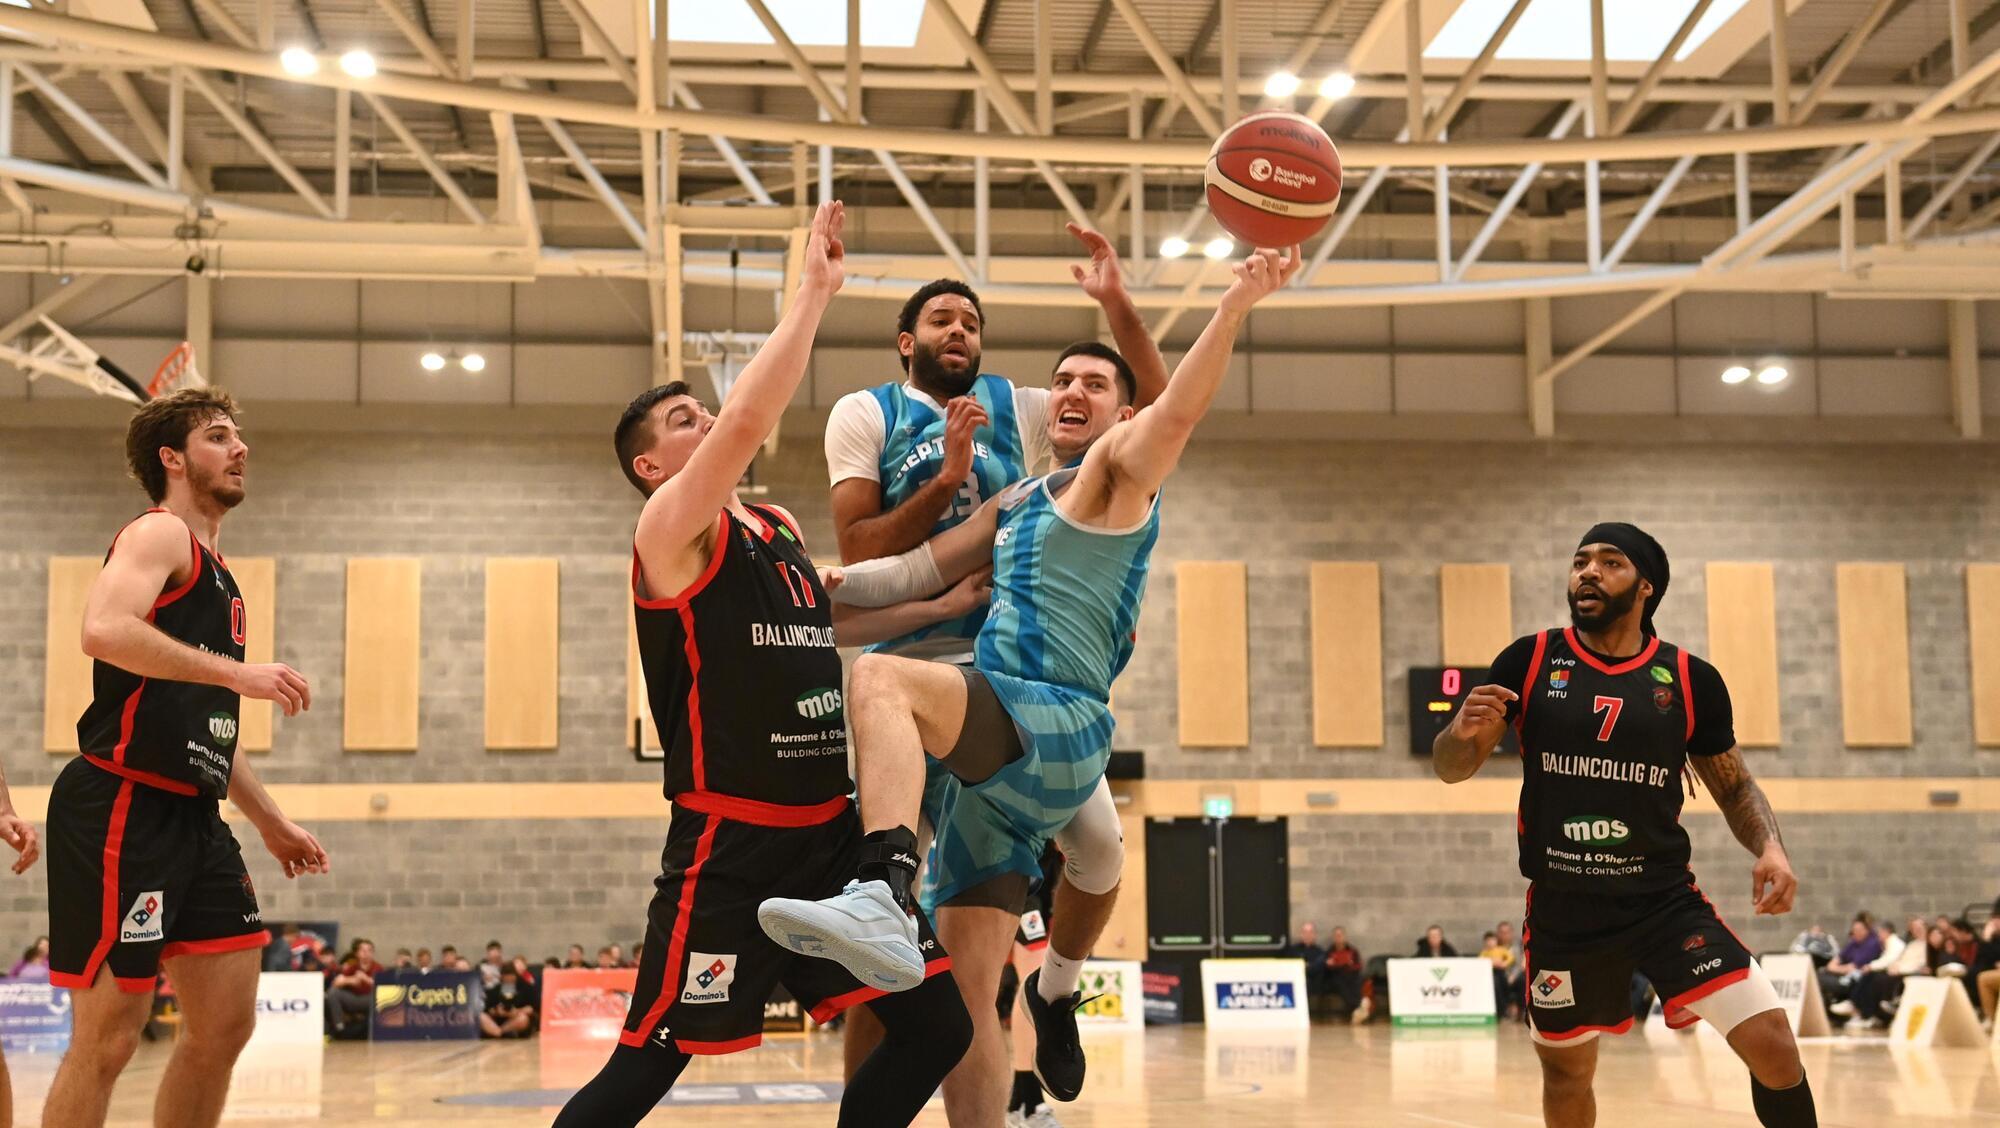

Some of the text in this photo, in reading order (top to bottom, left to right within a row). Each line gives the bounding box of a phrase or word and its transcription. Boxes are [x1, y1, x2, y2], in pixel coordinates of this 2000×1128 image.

[1273, 174, 1302, 189] Ireland
[1275, 166, 1316, 187] Basketball
[231, 597, 246, 646] 0
[1551, 657, 1576, 667] vive
[1442, 669, 1460, 696] 0
[1547, 690, 1567, 699] MTU
[797, 688, 842, 719] mos
[1593, 695, 1623, 742] 7
[770, 732, 819, 743] Murnane
[820, 730, 828, 740] &
[777, 747, 820, 758] BUILDING
[1542, 752, 1669, 787] BALLINCOLLIG BC
[1564, 819, 1629, 842] mos
[1584, 852, 1592, 862] &
[123, 928, 160, 939] Domino's
[918, 939, 934, 951] ve
[1692, 958, 1722, 976] vive
[684, 990, 726, 1001] Domino's
[1231, 982, 1277, 996] MTU
[1420, 984, 1462, 997] vive
[1535, 997, 1572, 1006] Domino's
